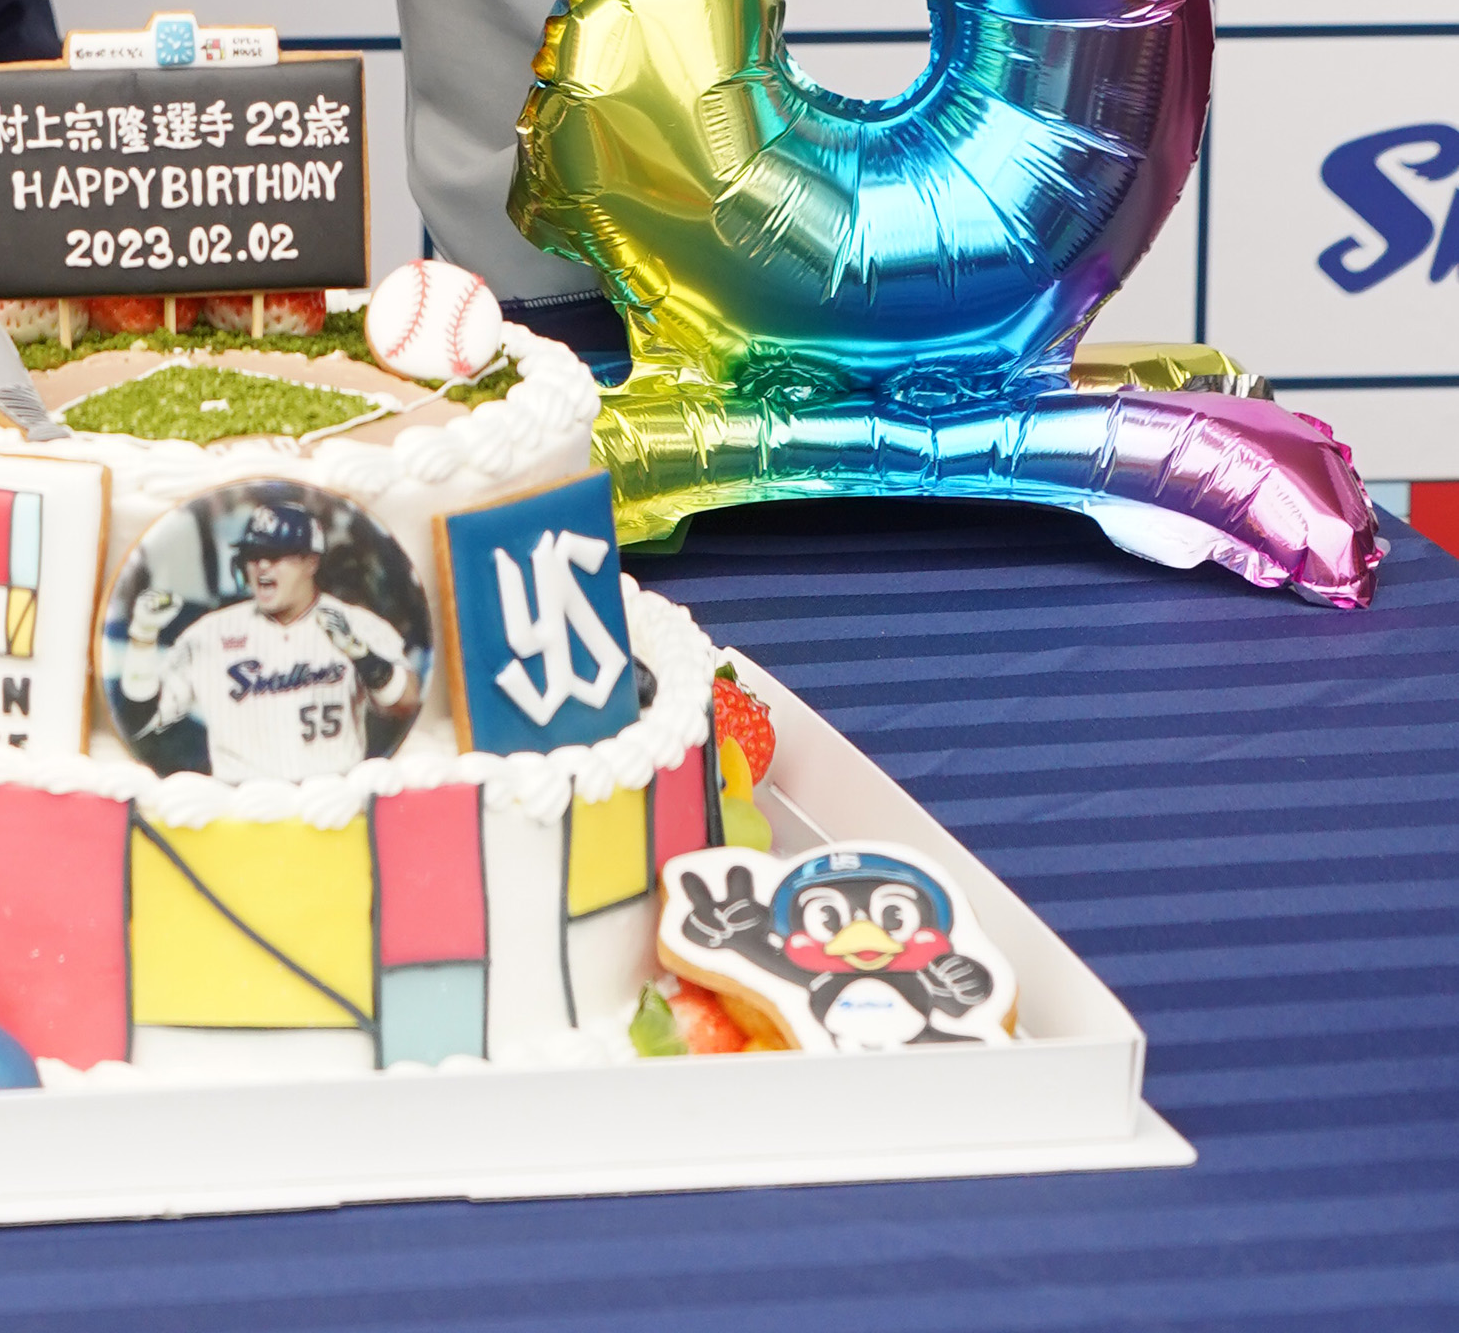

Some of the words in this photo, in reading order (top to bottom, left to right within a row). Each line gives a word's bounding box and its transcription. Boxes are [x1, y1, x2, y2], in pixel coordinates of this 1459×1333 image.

[245, 94, 351, 149] 23歳
[11, 165, 157, 211] HAPPY
[161, 160, 343, 209] BIRTHDAY
[65, 221, 299, 270] 2023.02.02
[299, 704, 343, 743] 55
